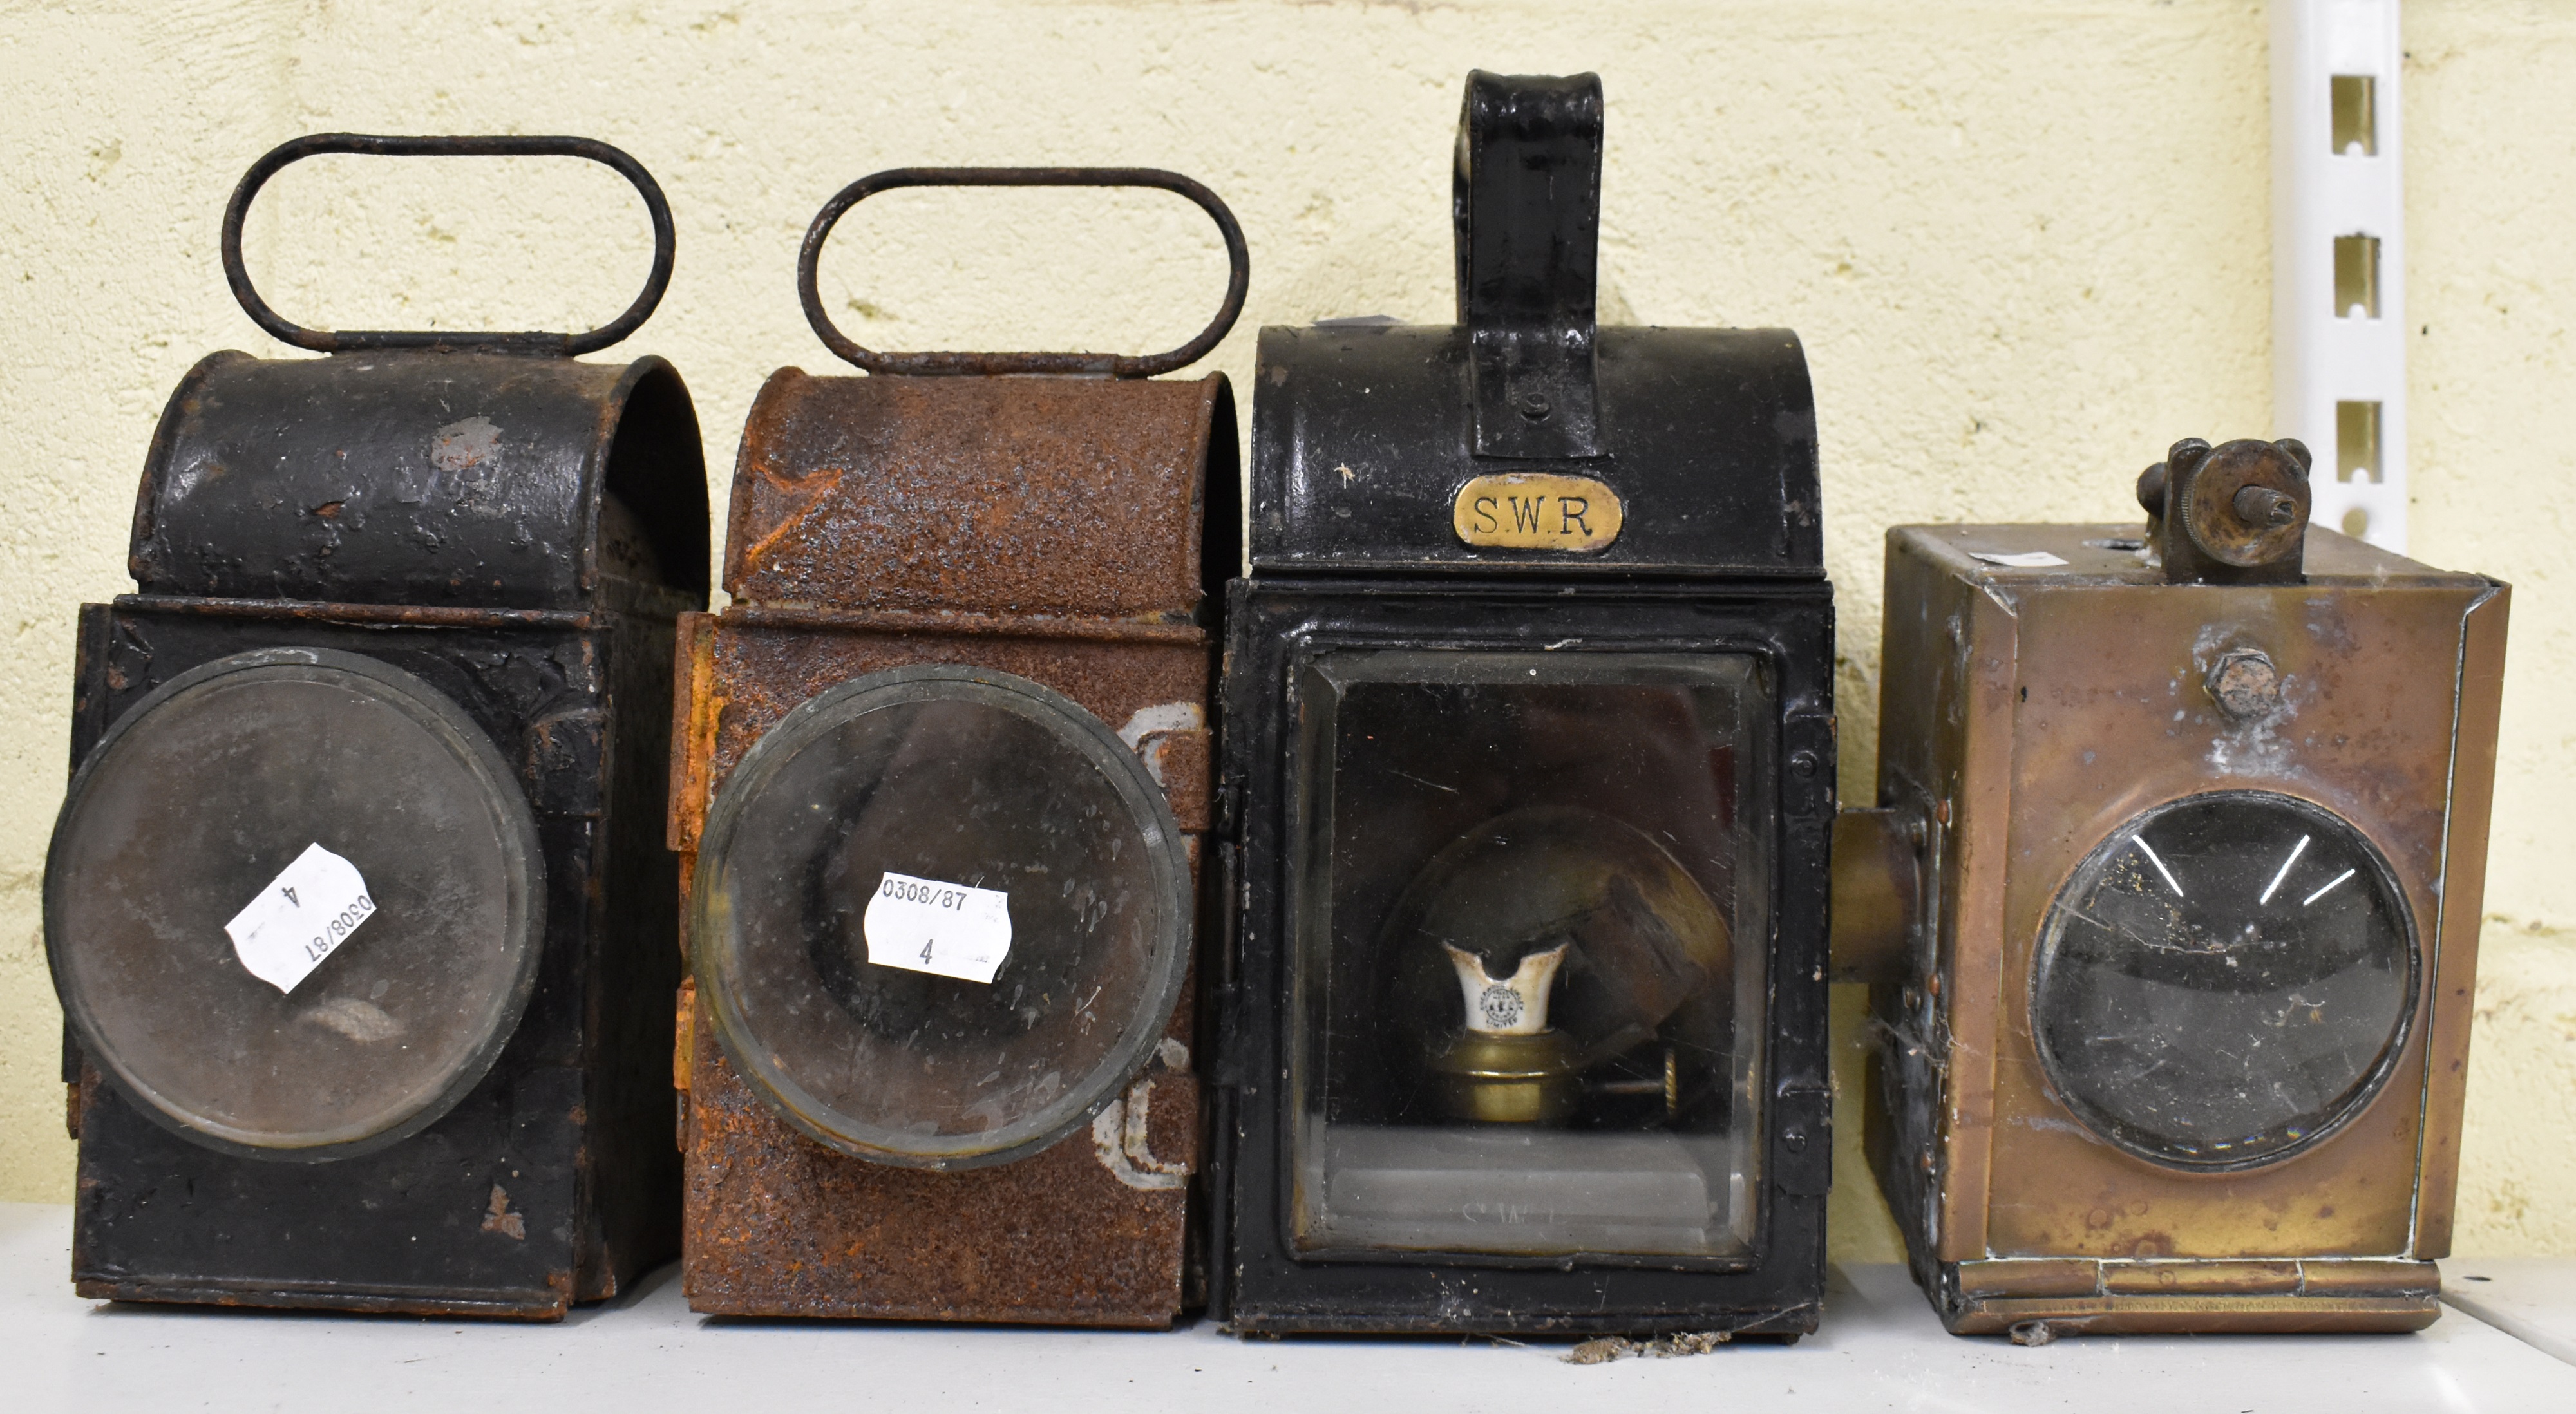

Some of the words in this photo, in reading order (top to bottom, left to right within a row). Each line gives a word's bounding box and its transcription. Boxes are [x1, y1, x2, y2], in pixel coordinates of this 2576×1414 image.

[1474, 496, 1593, 536] S.W.R
[281, 887, 301, 909] 4
[882, 879, 967, 911] 0308/87
[305, 894, 372, 962] 0308/87
[919, 938, 933, 965] 4
